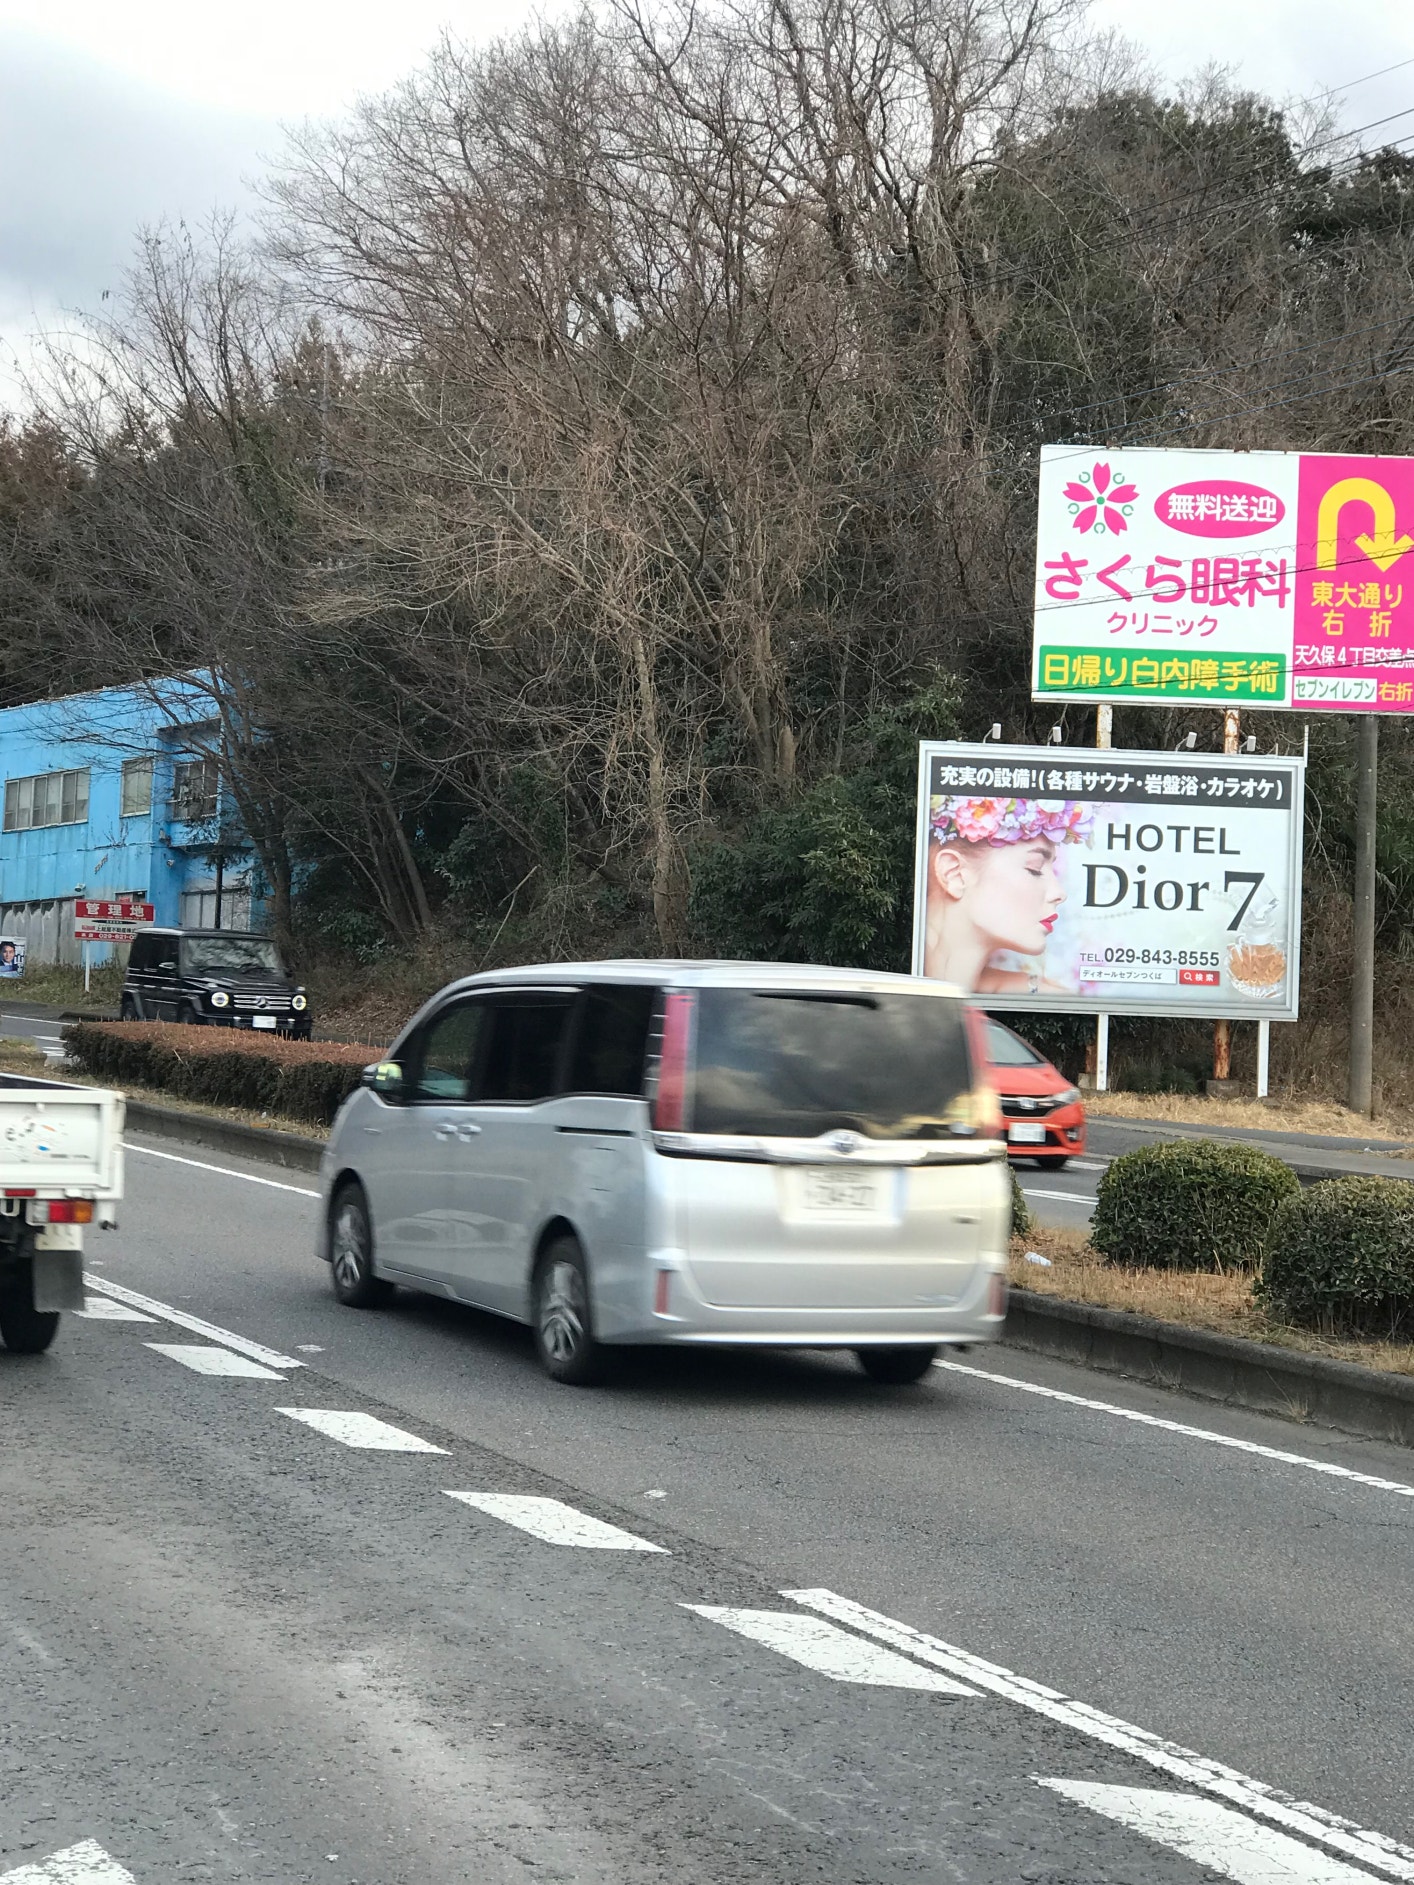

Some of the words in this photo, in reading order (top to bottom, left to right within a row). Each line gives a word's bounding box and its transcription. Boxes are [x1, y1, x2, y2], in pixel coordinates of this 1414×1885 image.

[1167, 492, 1278, 523] 無料送迎
[1043, 551, 1291, 609] さくら眼科
[1310, 580, 1403, 609] 東大通り
[1107, 611, 1218, 637] クリニック
[1044, 653, 1279, 694] 日帰り白内障手術
[1295, 678, 1376, 700] セブンイレブン
[1378, 681, 1413, 702] 右折
[1107, 822, 1241, 855] HOTEL
[86, 902, 144, 917] 管理地
[1082, 863, 1210, 912] Dior
[1223, 870, 1265, 932] 7
[1082, 969, 1163, 980] ディオールセブンつくば
[1195, 973, 1214, 982] 検索
